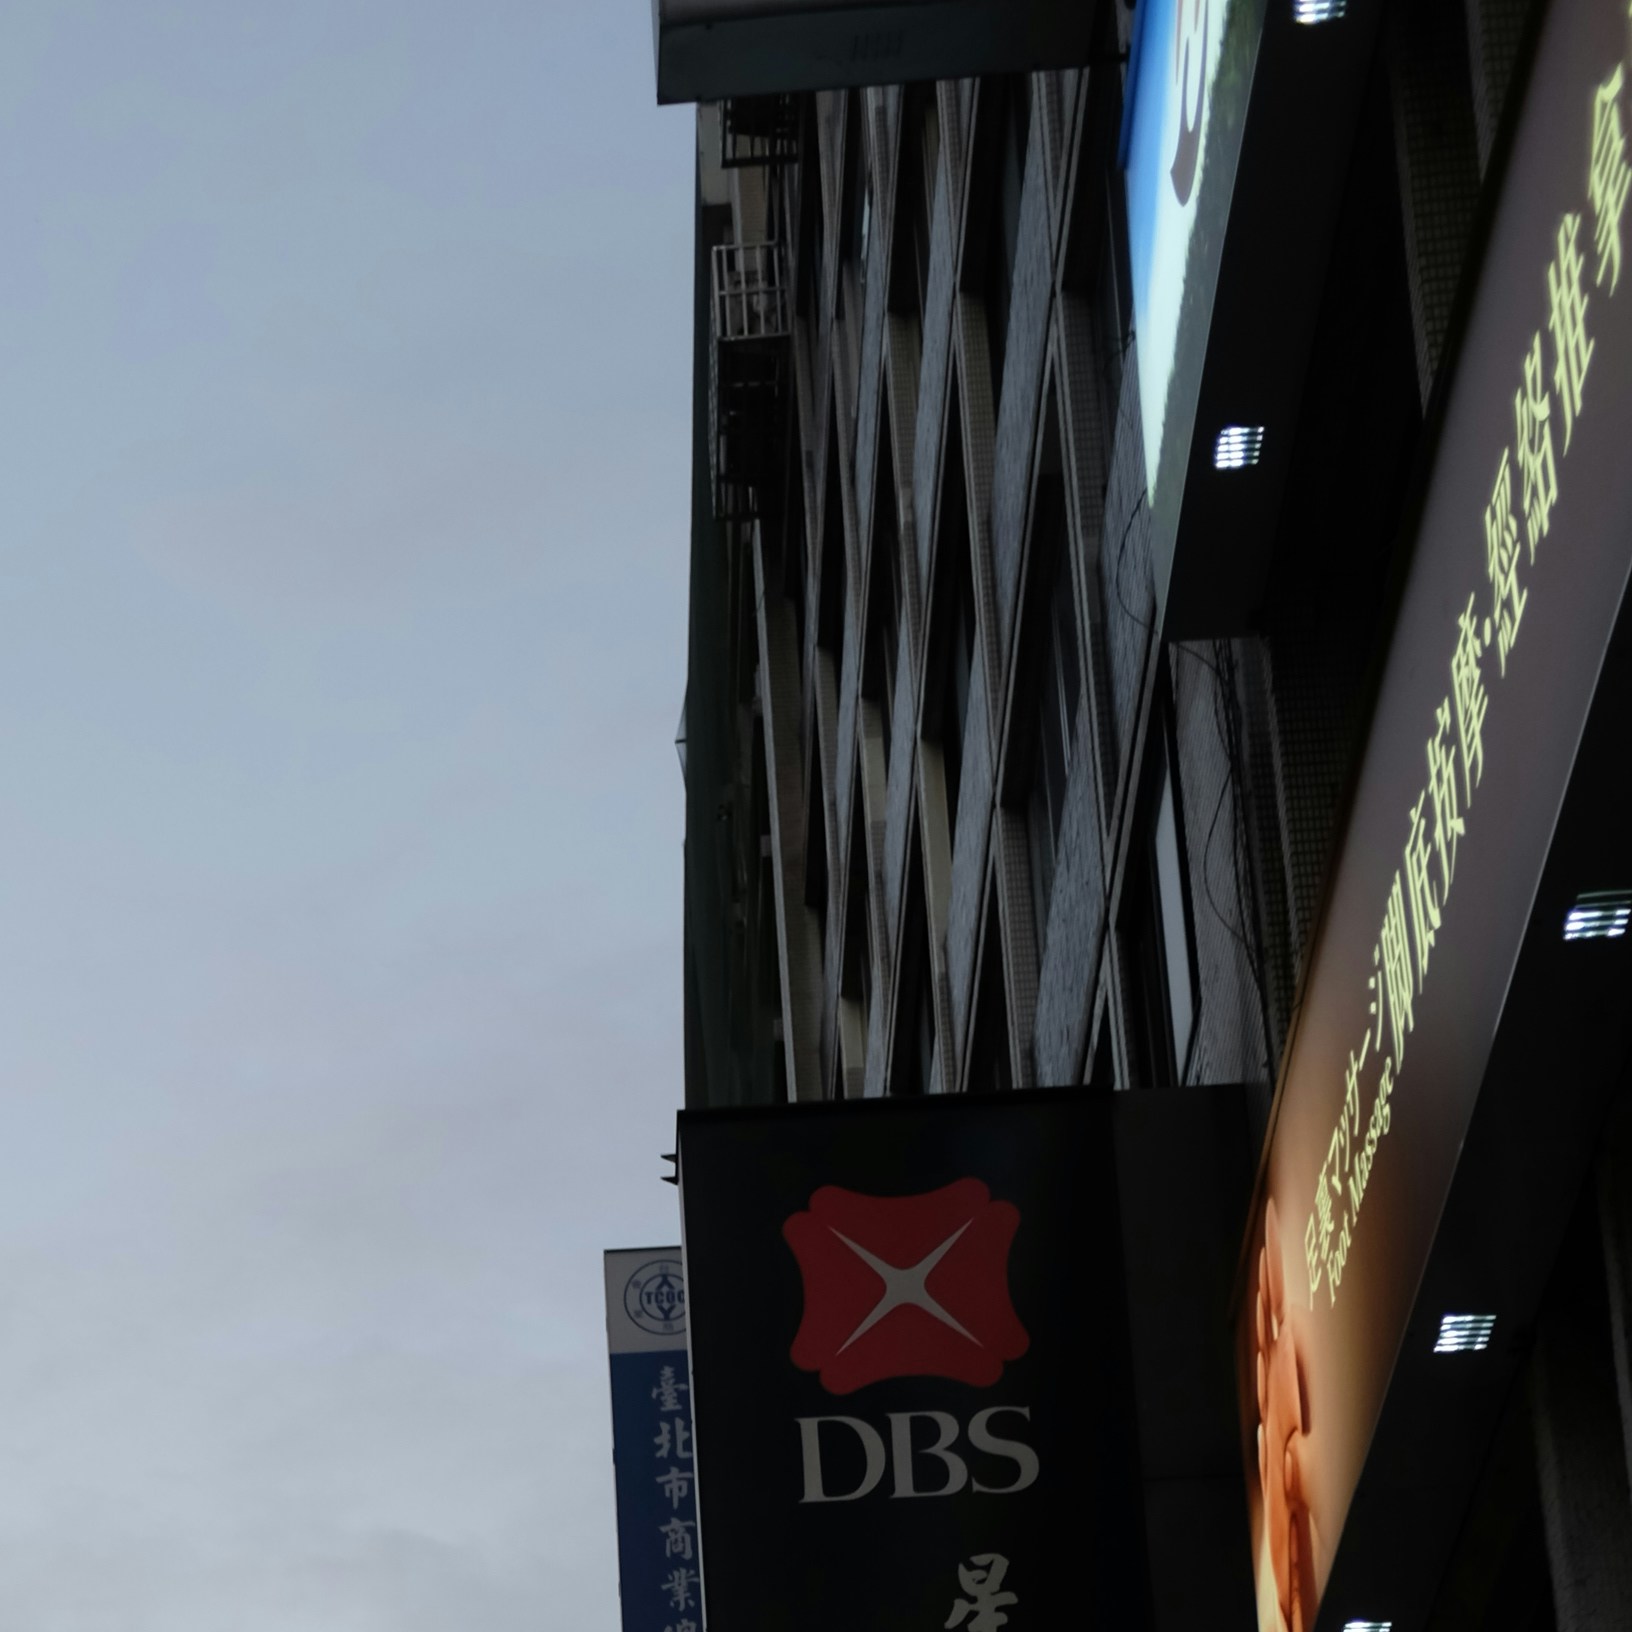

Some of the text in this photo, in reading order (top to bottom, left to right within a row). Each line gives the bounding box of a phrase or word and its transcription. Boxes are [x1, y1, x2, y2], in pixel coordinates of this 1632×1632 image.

[1326, 1056, 1394, 1309] Foot Massage
[794, 1403, 1042, 1506] DBS
